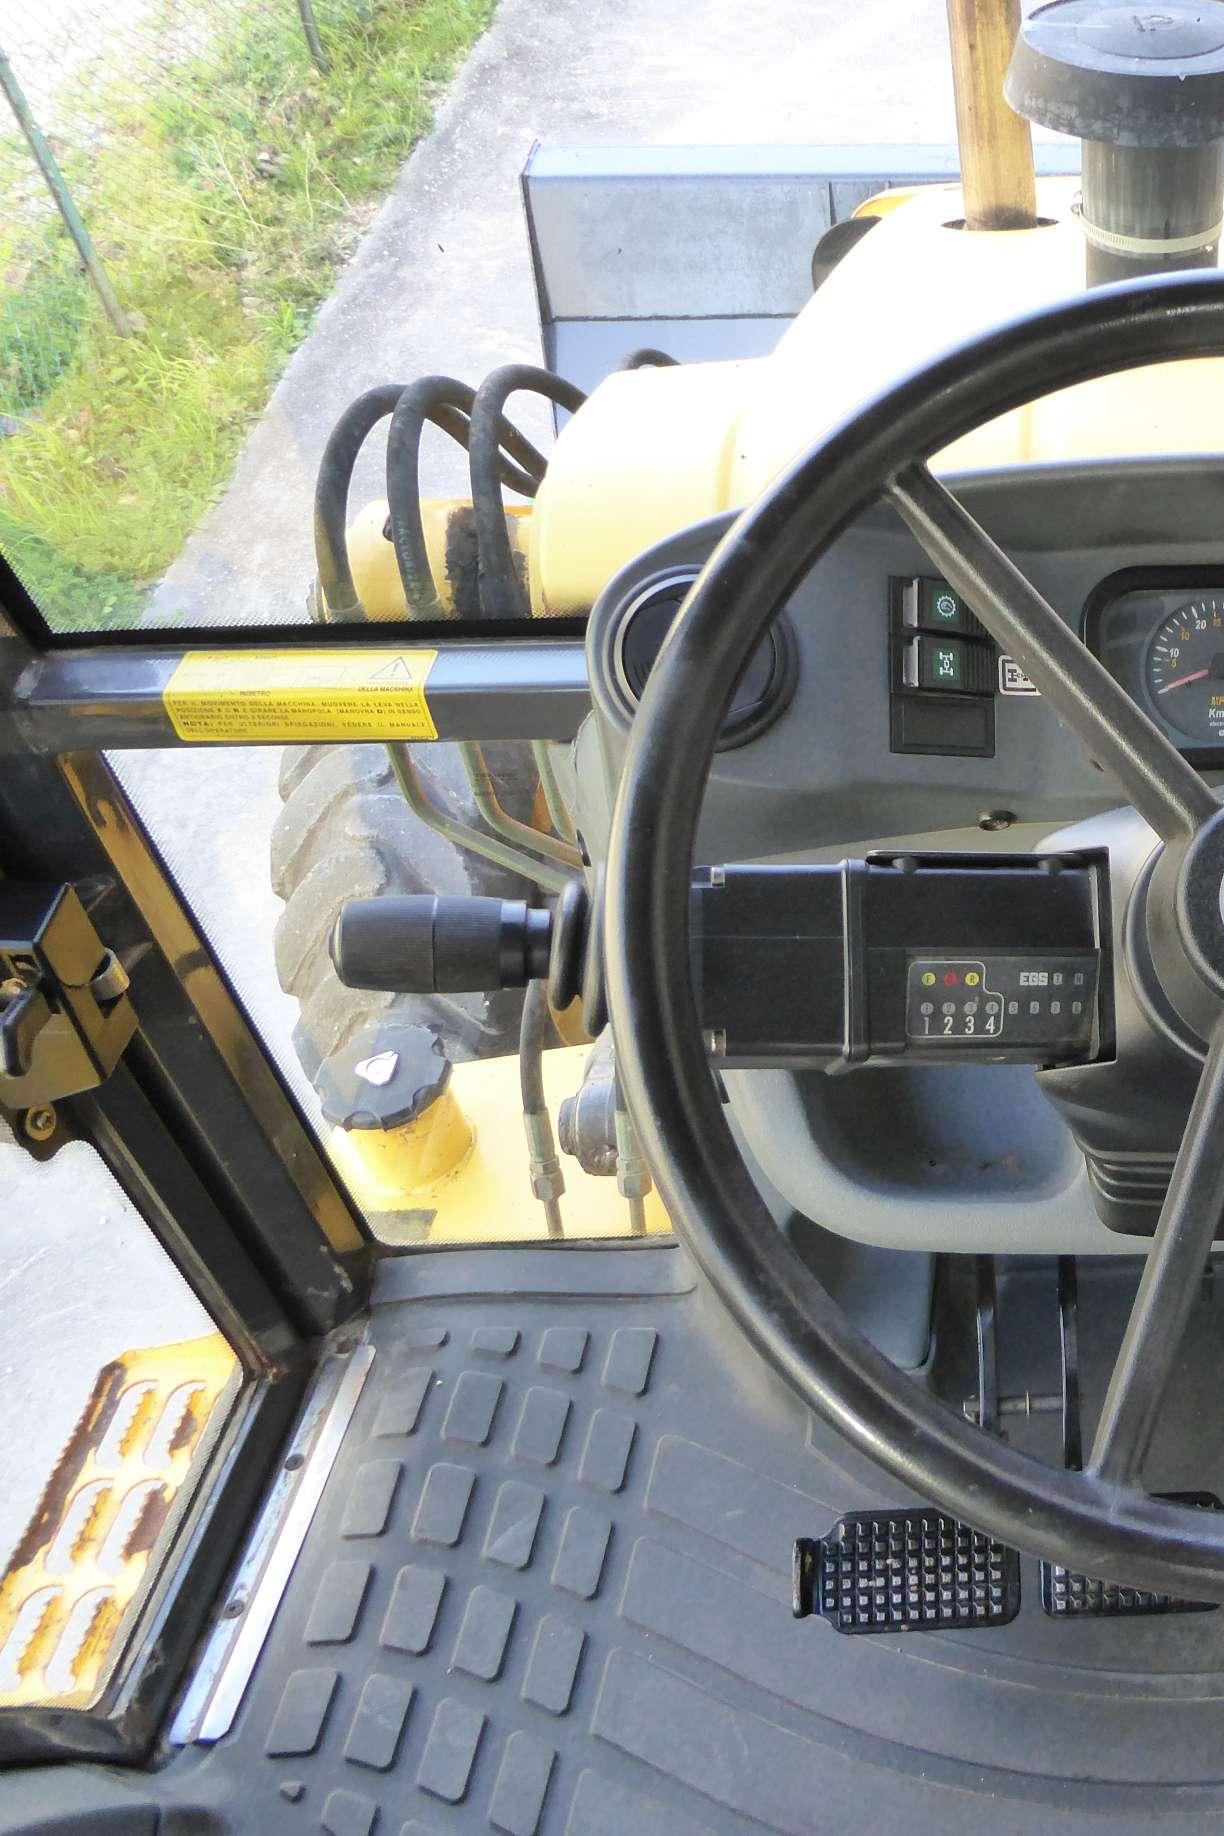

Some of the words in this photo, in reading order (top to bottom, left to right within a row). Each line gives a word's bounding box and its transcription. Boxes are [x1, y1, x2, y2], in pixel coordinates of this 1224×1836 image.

[1195, 620, 1206, 630] 20
[1180, 632, 1190, 640] 10
[1169, 648, 1180, 658] 10
[1171, 660, 1177, 668] 5
[1019, 972, 1048, 986] EGS
[923, 1017, 930, 1034] 1
[943, 1016, 953, 1034] 2
[965, 1016, 974, 1034] 3
[985, 1016, 995, 1034] 4
